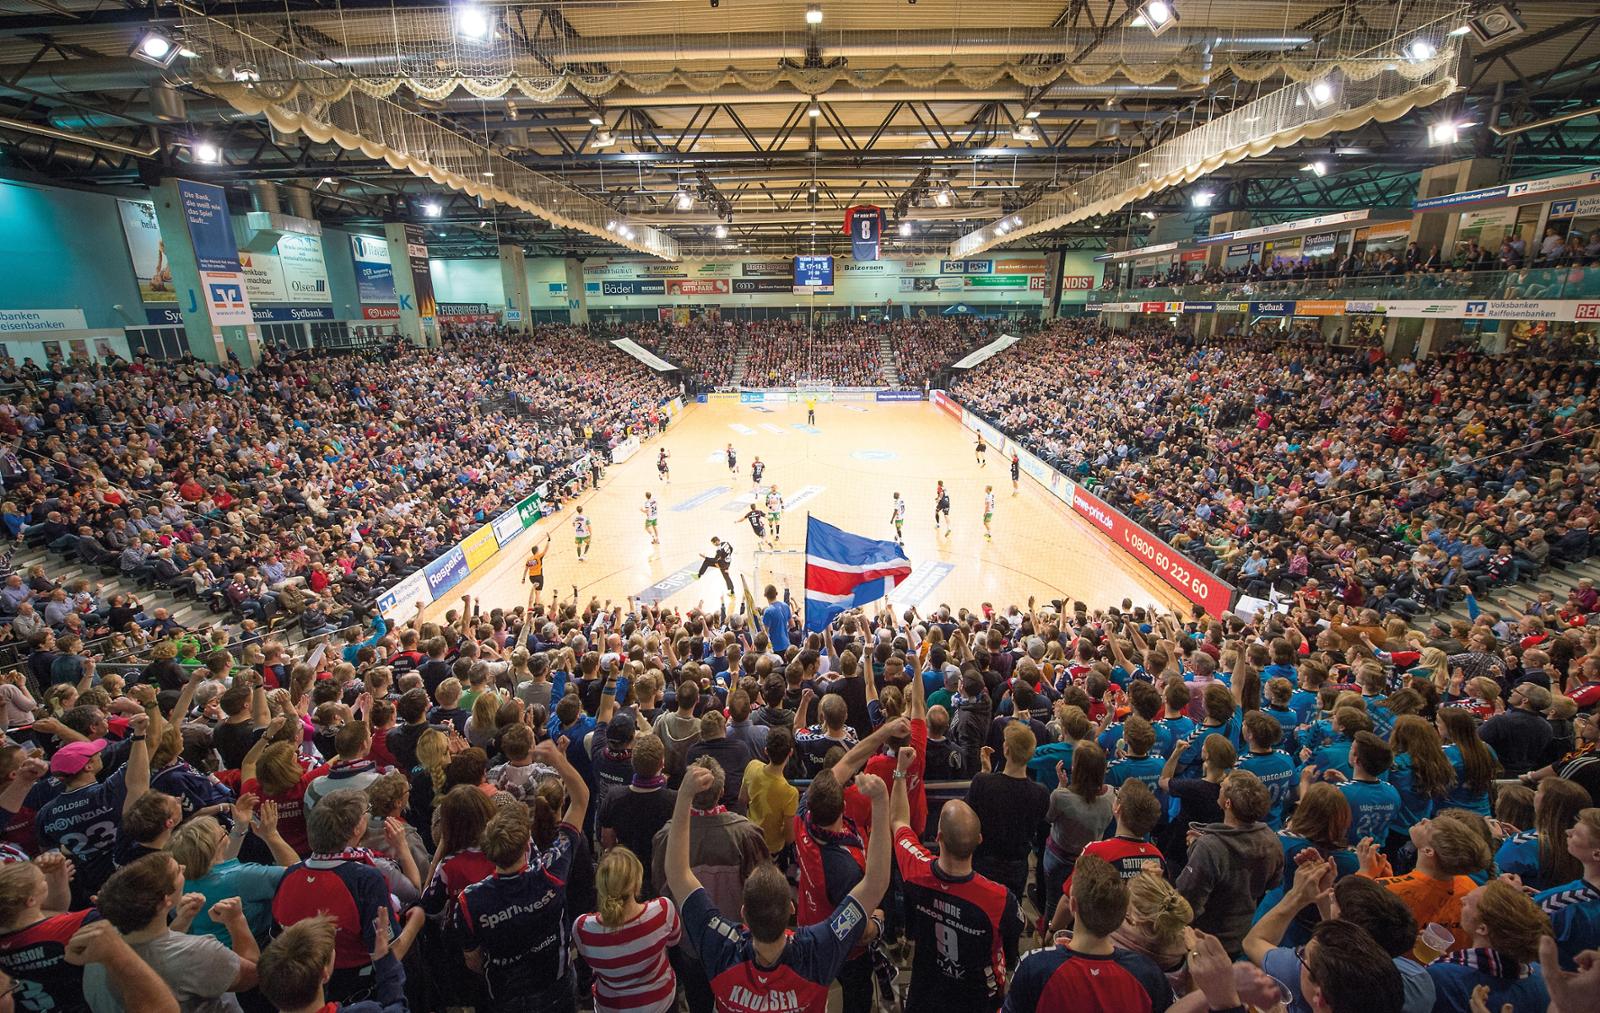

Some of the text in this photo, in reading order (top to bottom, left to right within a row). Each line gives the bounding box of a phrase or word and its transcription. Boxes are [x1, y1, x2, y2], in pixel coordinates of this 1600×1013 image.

[184, 191, 194, 199] Die
[199, 209, 213, 218] Spiel
[861, 220, 871, 239] 8
[1306, 232, 1336, 245] Sydbank
[291, 280, 316, 292] Olsen
[604, 283, 635, 294] Bäder!
[1031, 277, 1092, 289] RENDIS
[188, 288, 198, 313] J
[399, 294, 413, 310] K
[508, 297, 517, 309] L
[568, 299, 580, 309] M
[1491, 301, 1539, 309] Volksbanken
[290, 308, 324, 320] Sydbank
[1258, 303, 1285, 313] Sydbank
[1488, 309, 1556, 318] Raiffeisenbanken
[0, 312, 40, 321] banken
[1131, 534, 1208, 599] 0800 60 222 60
[59, 820, 118, 855] 23
[916, 903, 943, 922] JACOB
[932, 898, 961, 920] ANDRE
[934, 922, 959, 962] 9
